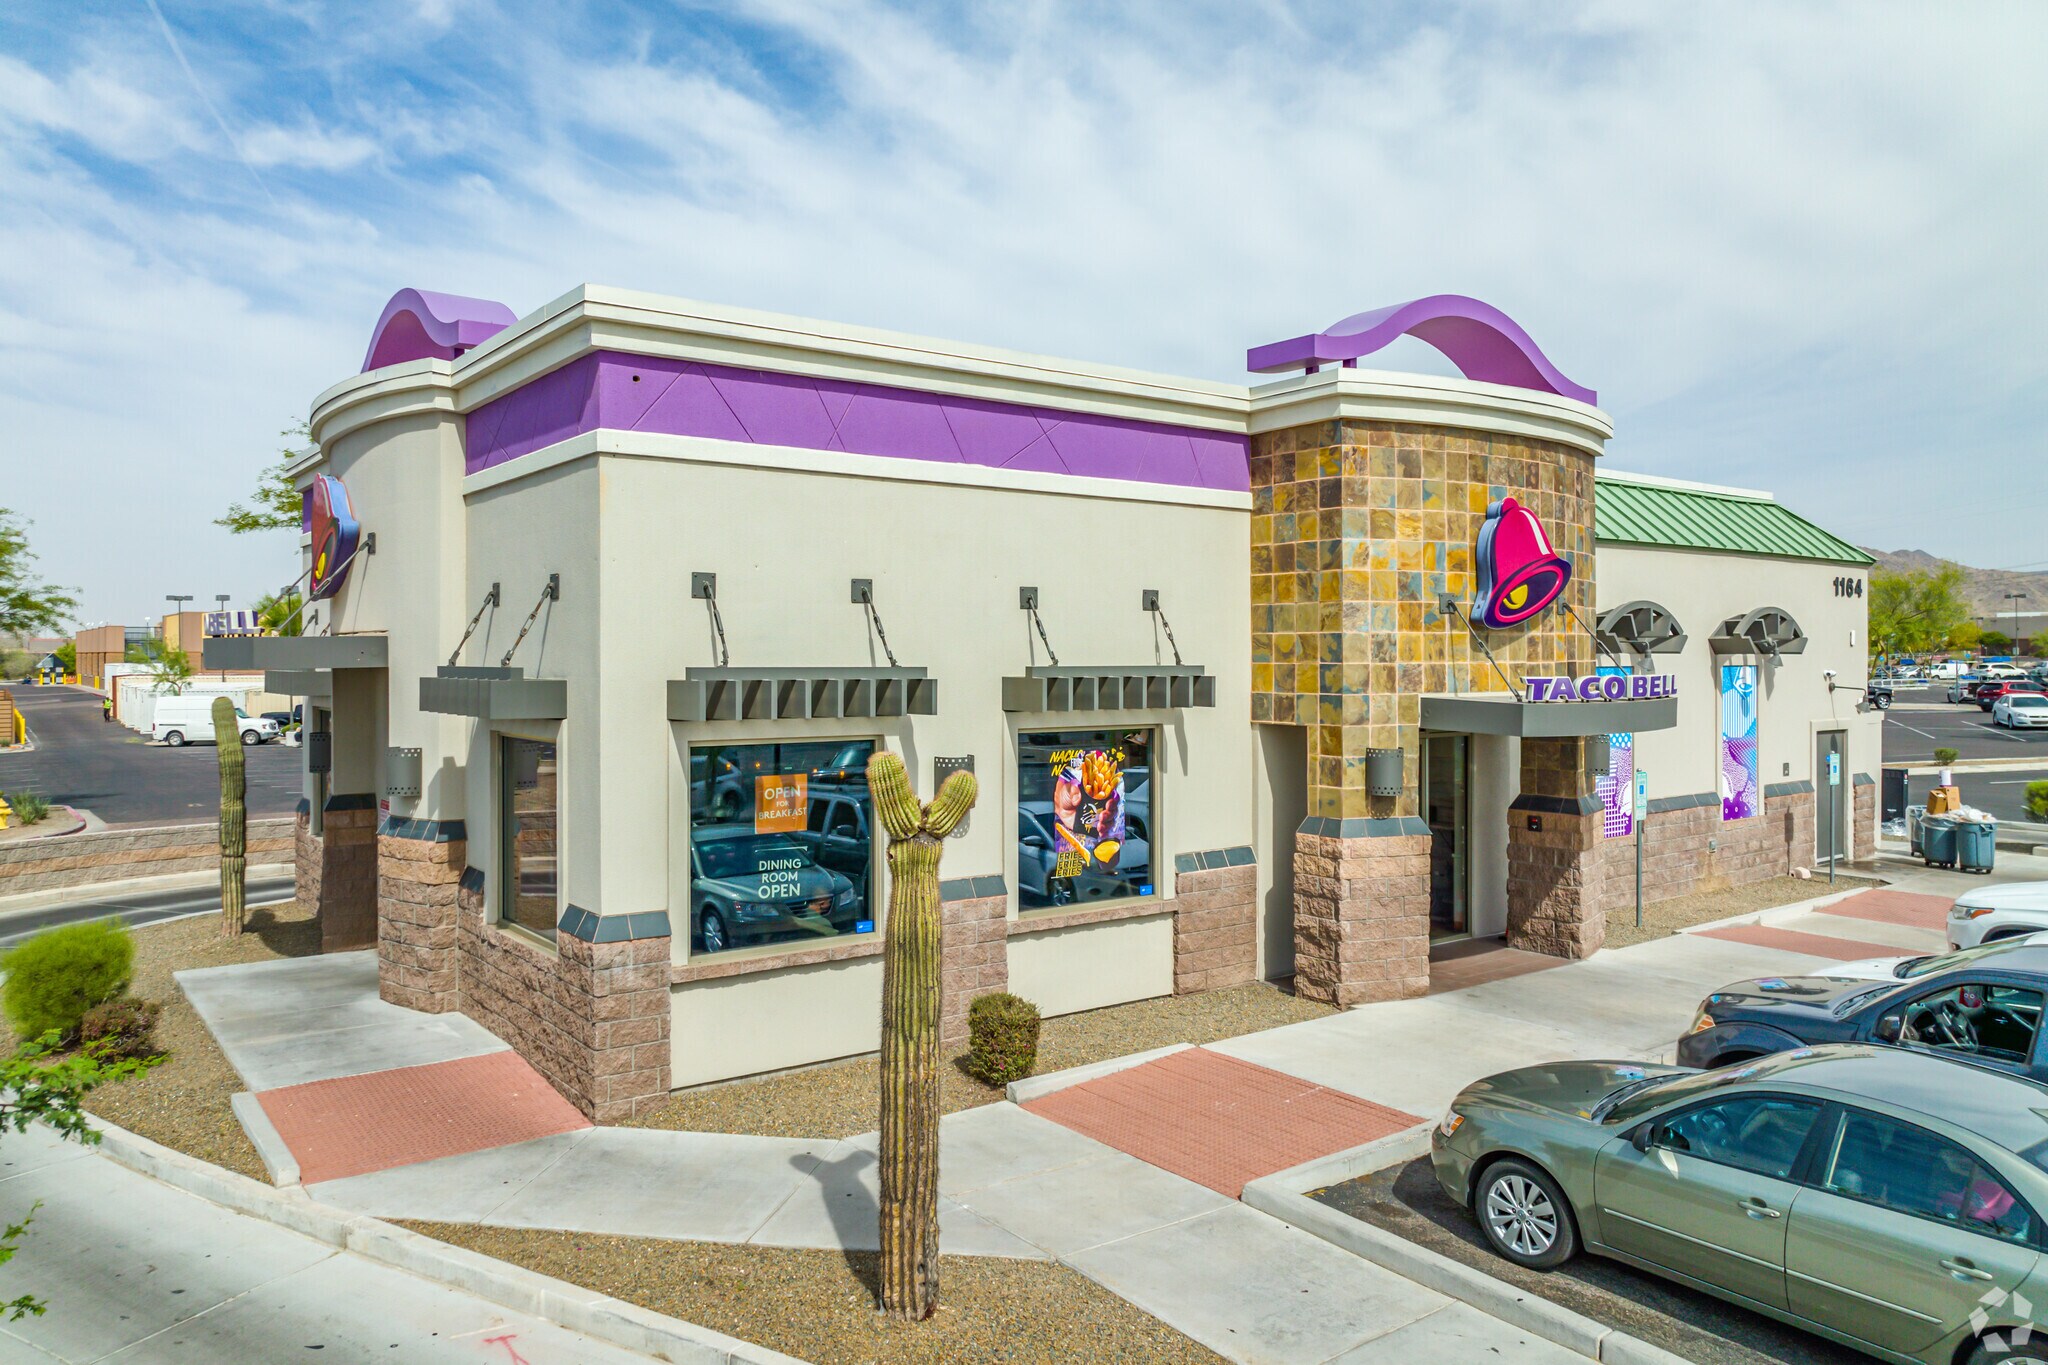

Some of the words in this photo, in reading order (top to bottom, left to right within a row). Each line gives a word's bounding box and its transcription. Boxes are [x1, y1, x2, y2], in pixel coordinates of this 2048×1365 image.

[1832, 576, 1863, 598] 1164
[205, 610, 262, 635] BELL
[1525, 676, 1626, 700] TACO
[1631, 674, 1677, 698] BELL
[764, 785, 801, 800] OPEN
[758, 807, 807, 820] BREAKFAST
[759, 858, 802, 871] DINING
[761, 871, 798, 883] ROOM
[758, 883, 801, 899] OPEN
